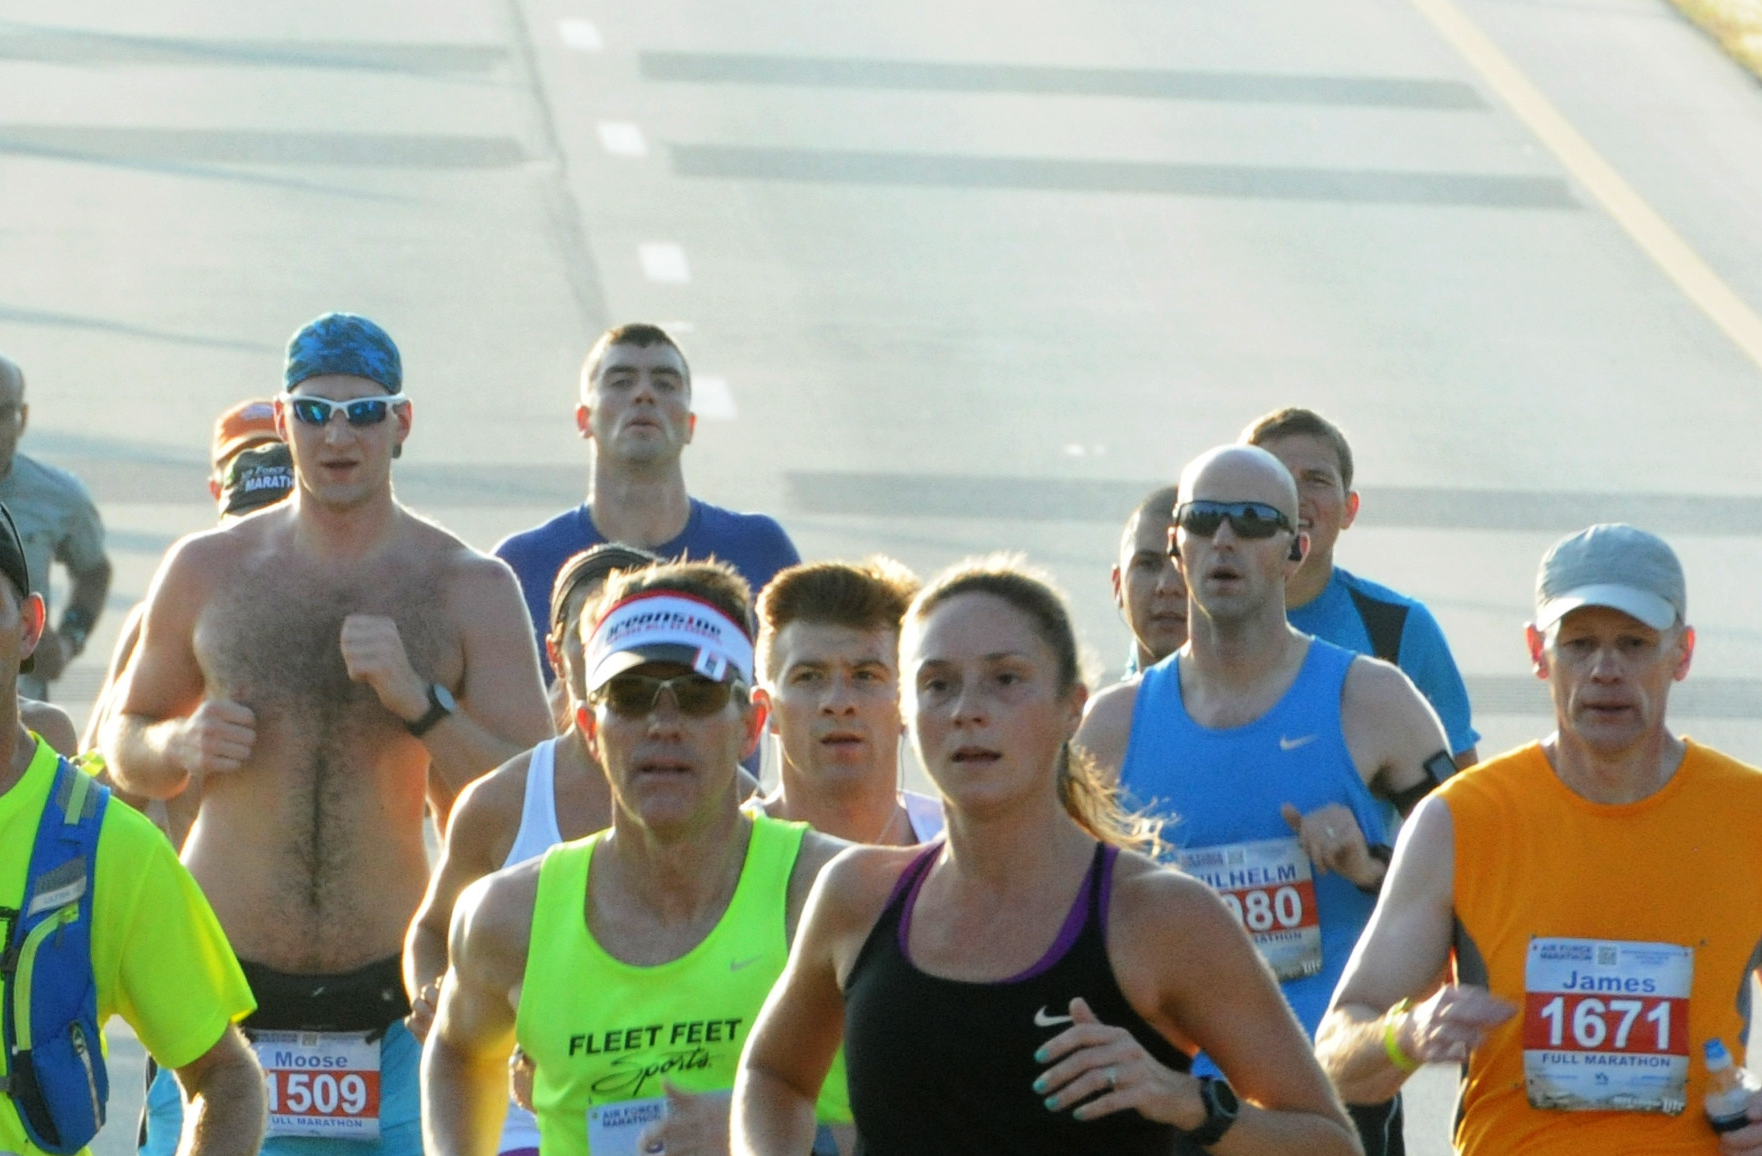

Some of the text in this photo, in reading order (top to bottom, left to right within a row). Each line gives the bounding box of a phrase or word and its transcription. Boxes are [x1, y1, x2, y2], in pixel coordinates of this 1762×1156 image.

[245, 475, 295, 492] MARATH
[1562, 970, 1656, 993] James
[1541, 996, 1671, 1050] 1671
[568, 1018, 742, 1056] FLEET FEET
[275, 1051, 348, 1068] Moose
[1542, 1053, 1671, 1067] FULL MARATHON
[267, 1073, 366, 1114] 1509
[271, 1116, 362, 1127] ULL MARATHON
